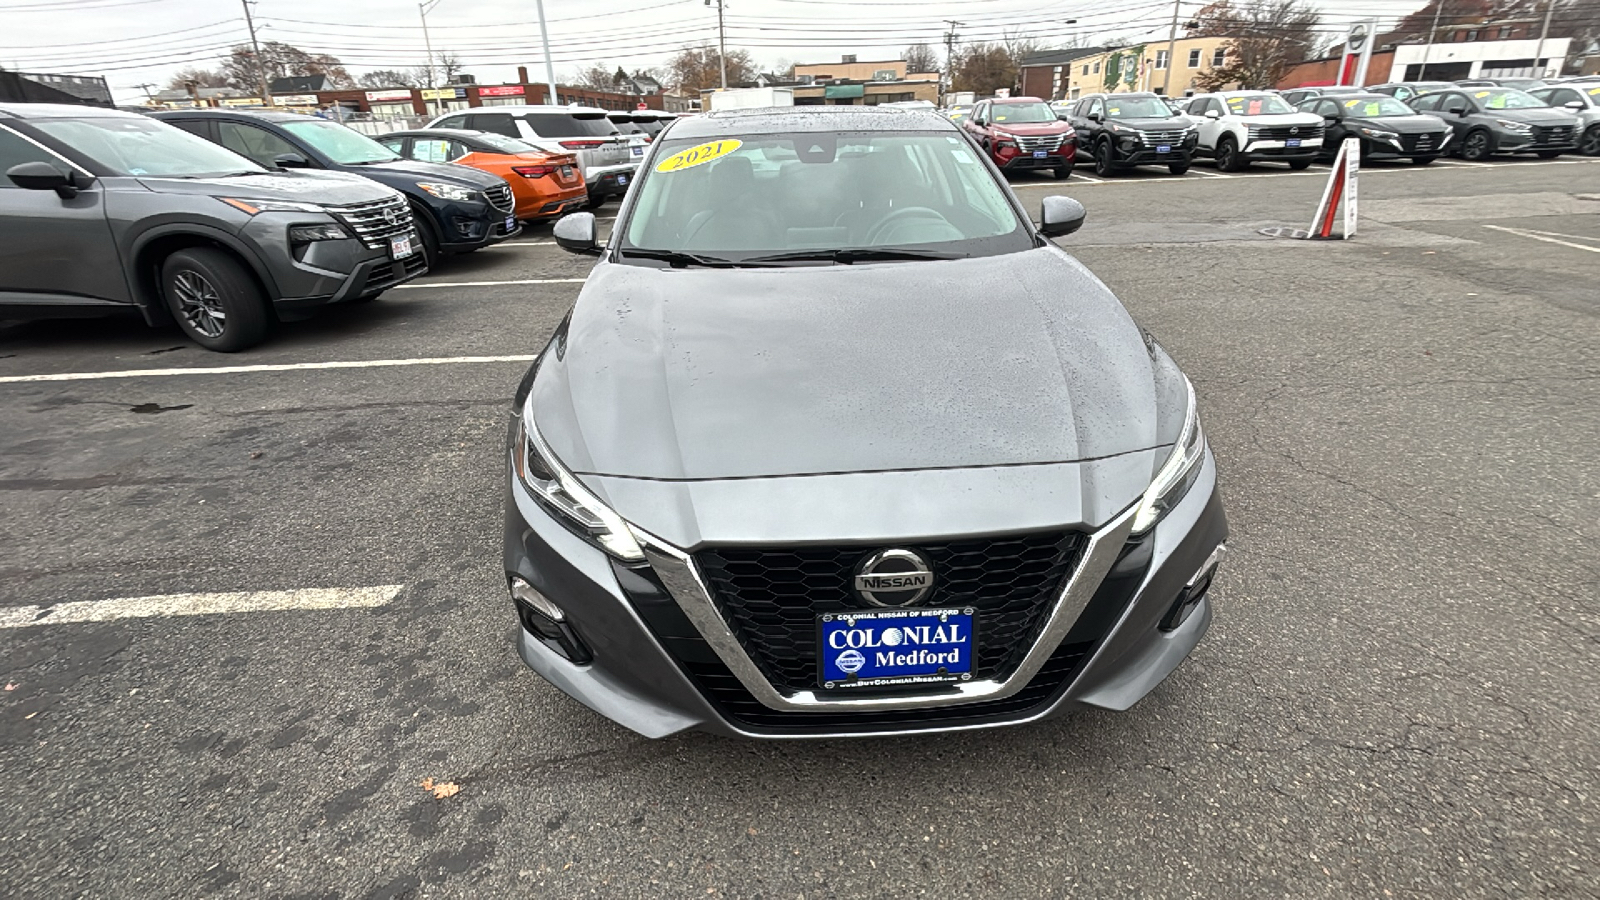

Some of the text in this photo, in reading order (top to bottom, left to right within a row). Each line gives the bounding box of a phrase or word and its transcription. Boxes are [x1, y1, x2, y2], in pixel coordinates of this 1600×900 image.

[672, 142, 722, 169] 2021
[864, 576, 926, 589] NISSAN
[837, 613, 877, 621] COLONIAL
[878, 611, 908, 619] NISSAN
[921, 609, 959, 617] MEDFORD
[829, 624, 967, 649] COLONIAL
[875, 648, 960, 667] Medford
